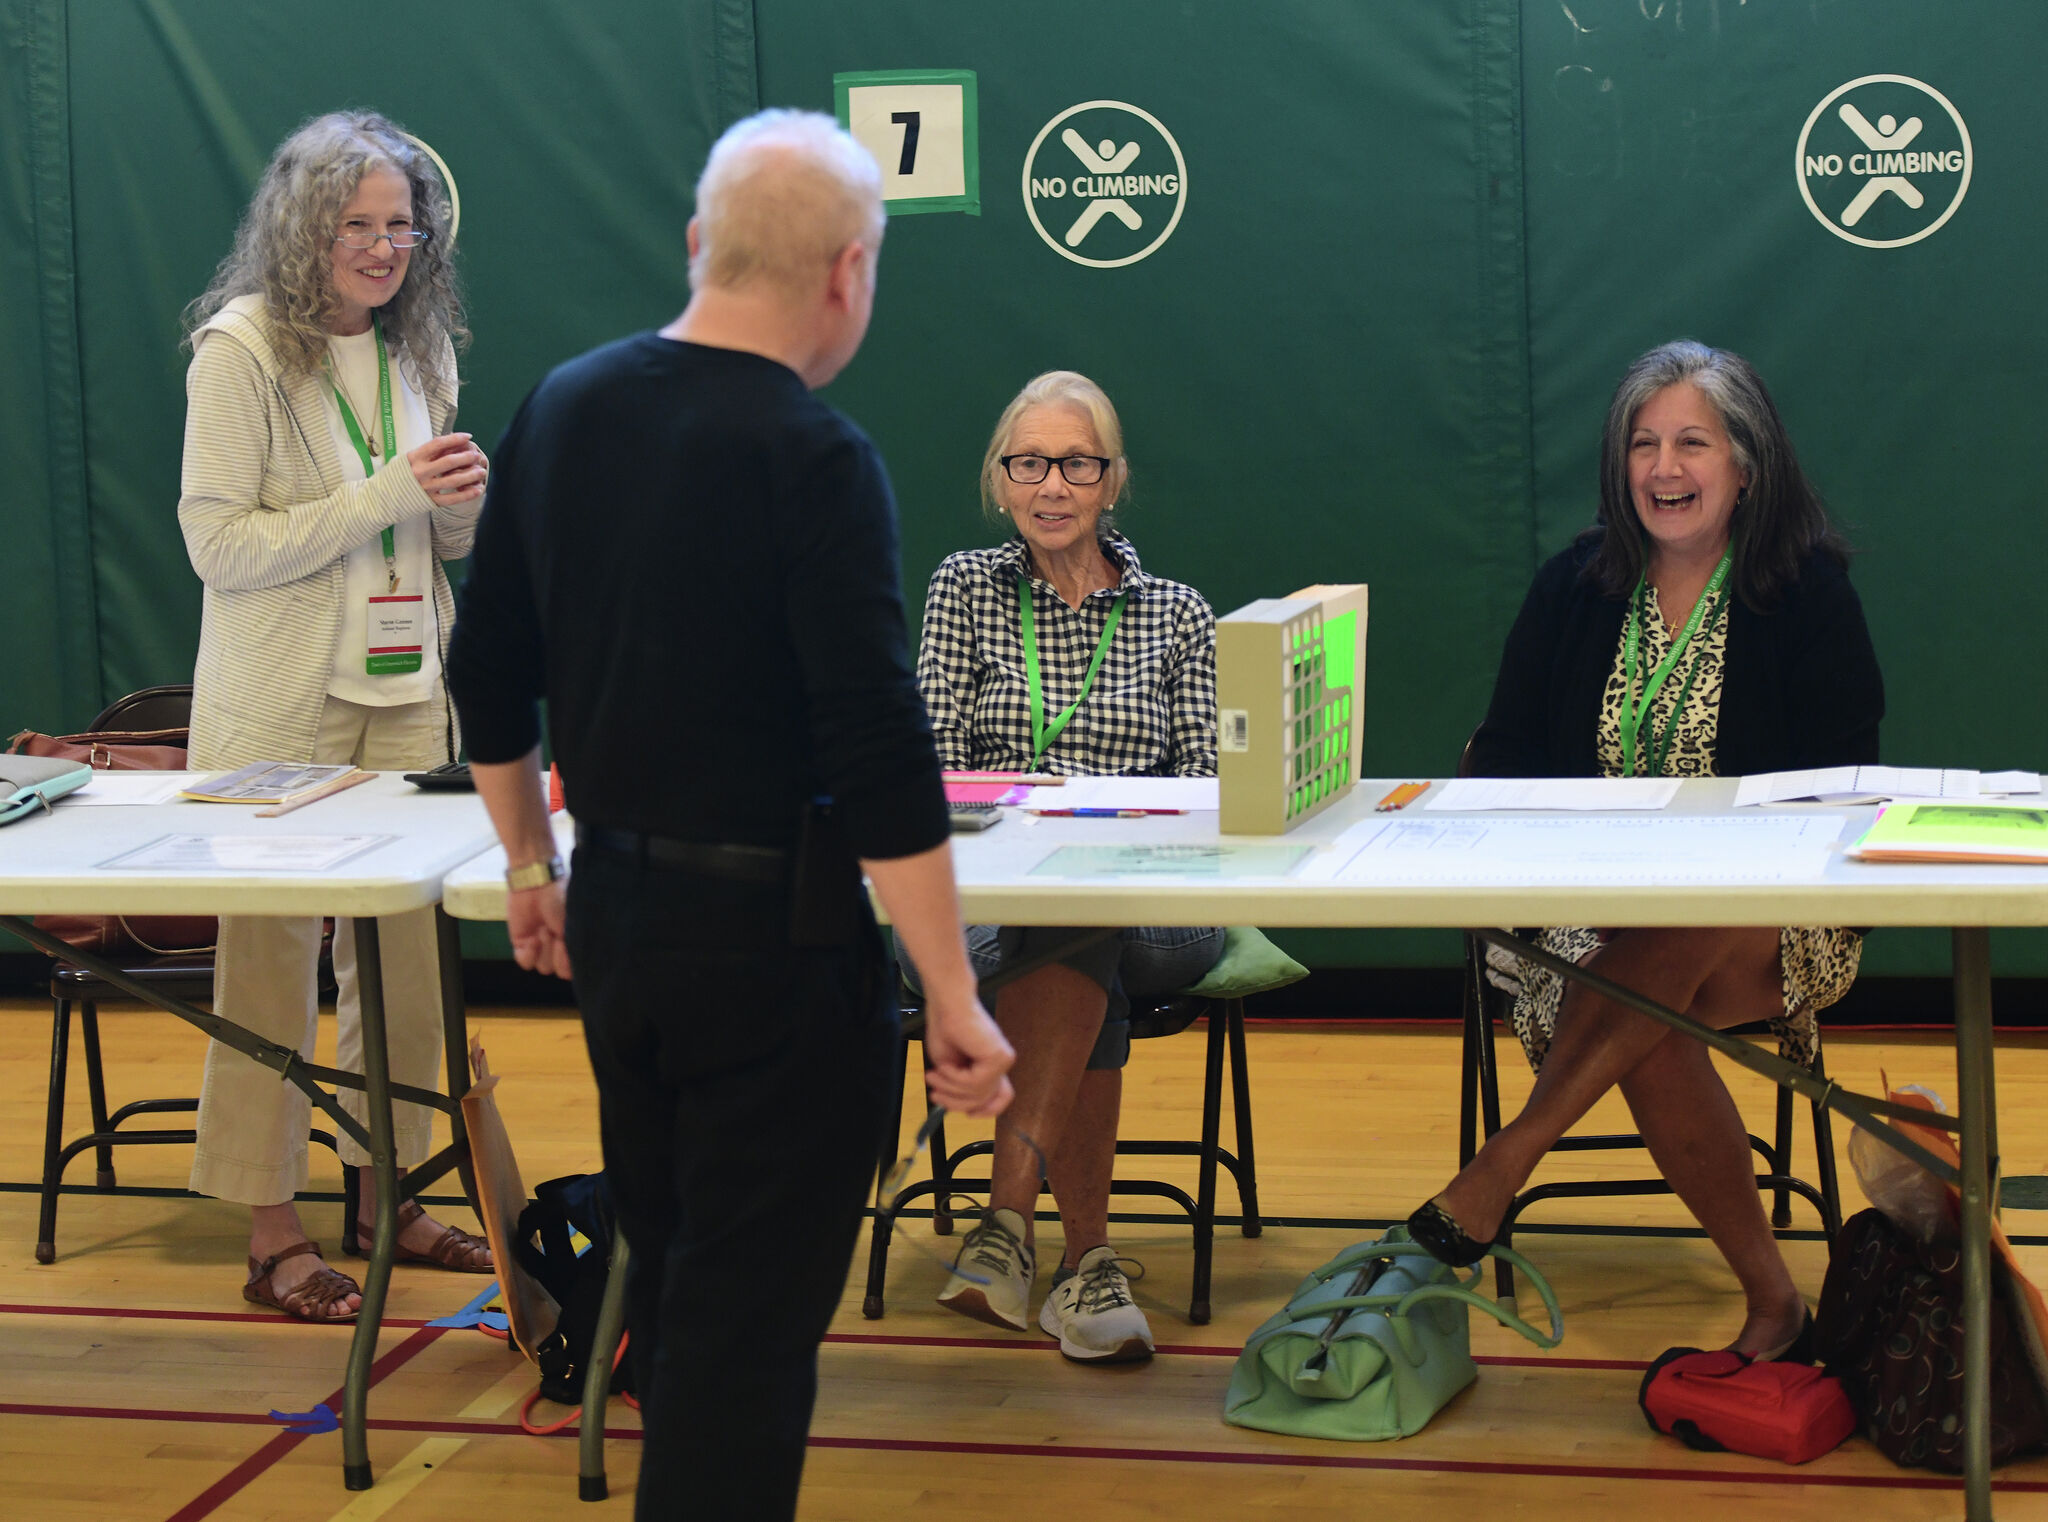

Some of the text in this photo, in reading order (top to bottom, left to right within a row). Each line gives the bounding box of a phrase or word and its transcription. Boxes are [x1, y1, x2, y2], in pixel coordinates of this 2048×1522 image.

[891, 111, 920, 175] 7
[1805, 150, 1964, 177] NO CLIMBING
[1031, 174, 1179, 199] NO CLIMBING
[382, 369, 392, 414] Greenwich
[384, 415, 394, 450] Elections
[1665, 557, 1732, 666] Town of Greenwich Elections
[1628, 640, 1636, 663] Town
